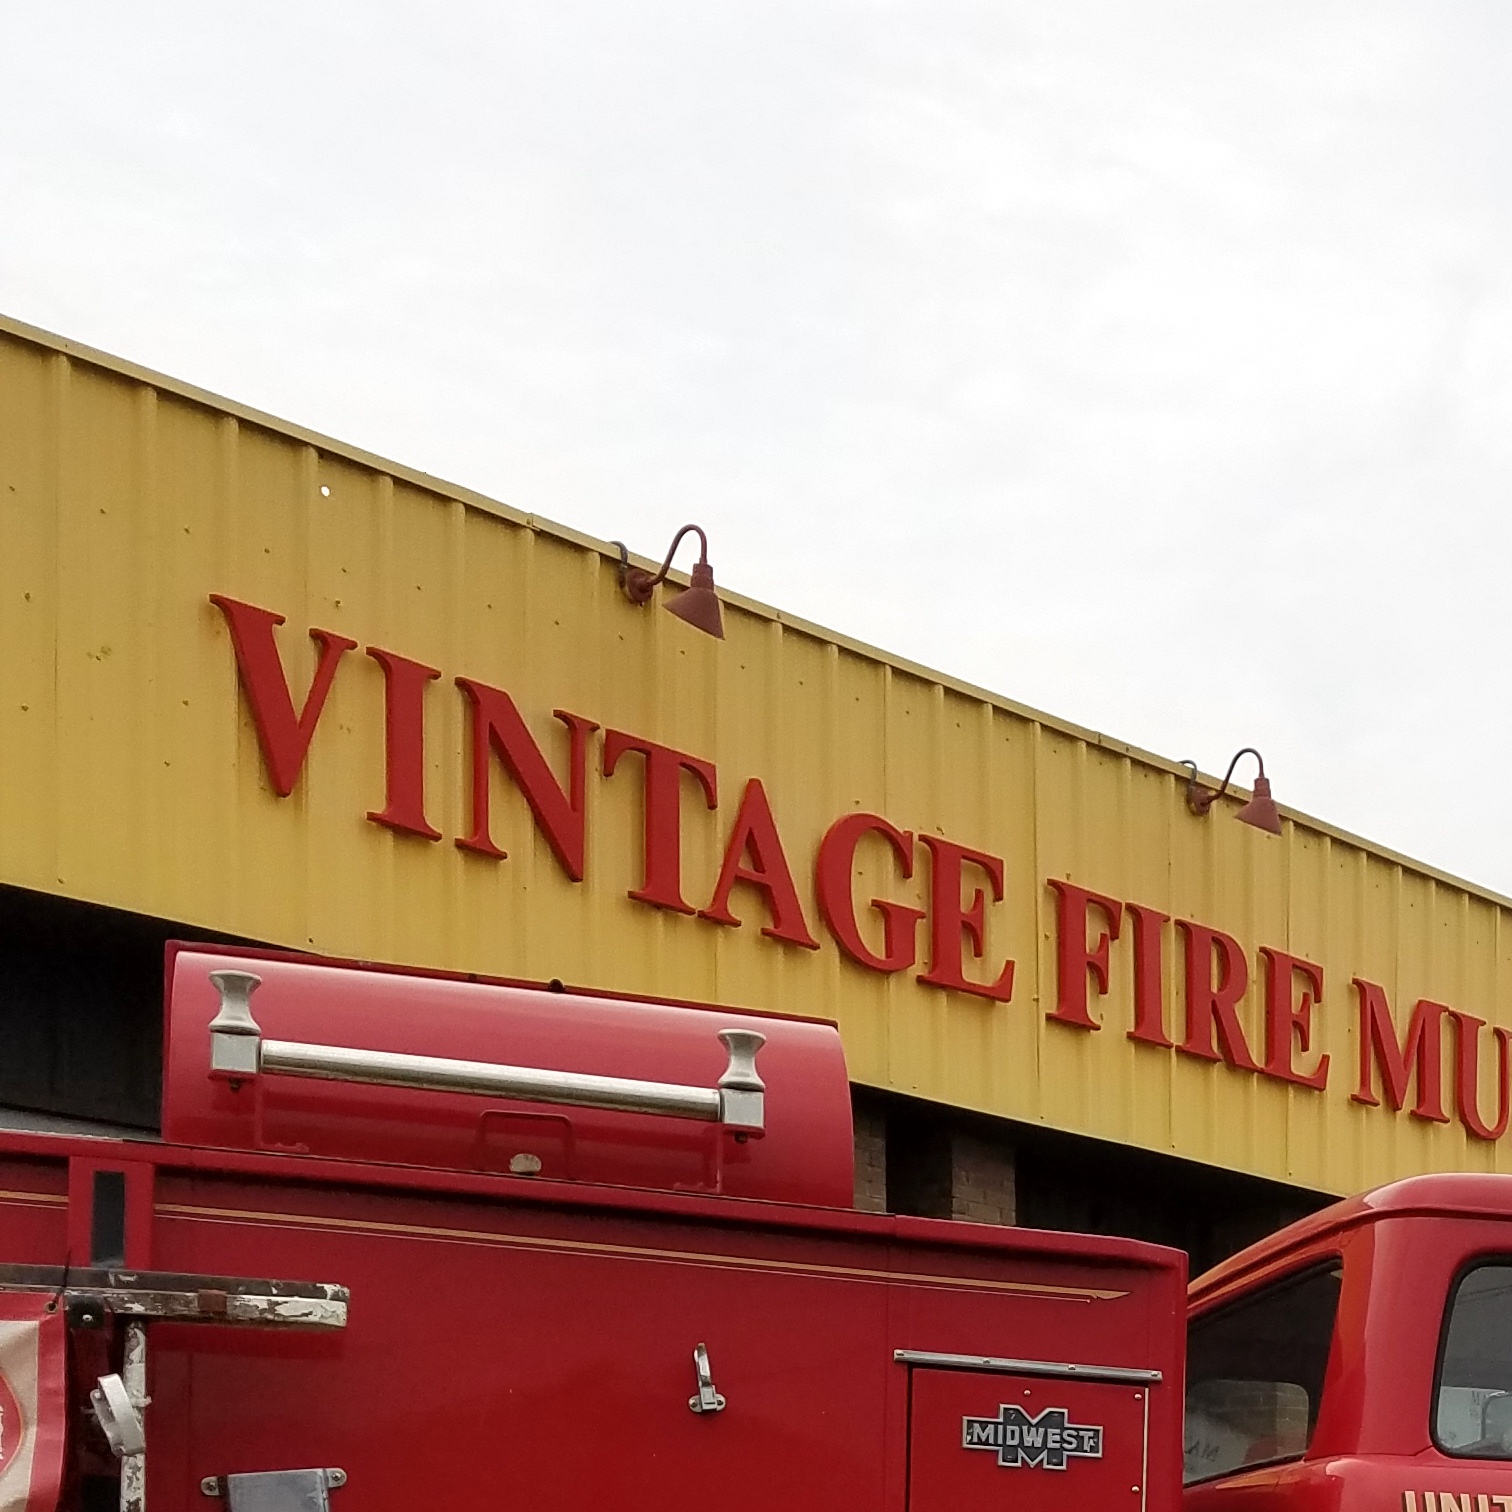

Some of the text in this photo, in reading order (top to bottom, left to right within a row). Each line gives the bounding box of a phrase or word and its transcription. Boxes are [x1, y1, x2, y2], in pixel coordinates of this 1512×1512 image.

[209, 593, 1016, 1002] VINTAGE
[1045, 877, 1330, 1091] FIRE
[971, 1422, 1095, 1453] MIDWEST
